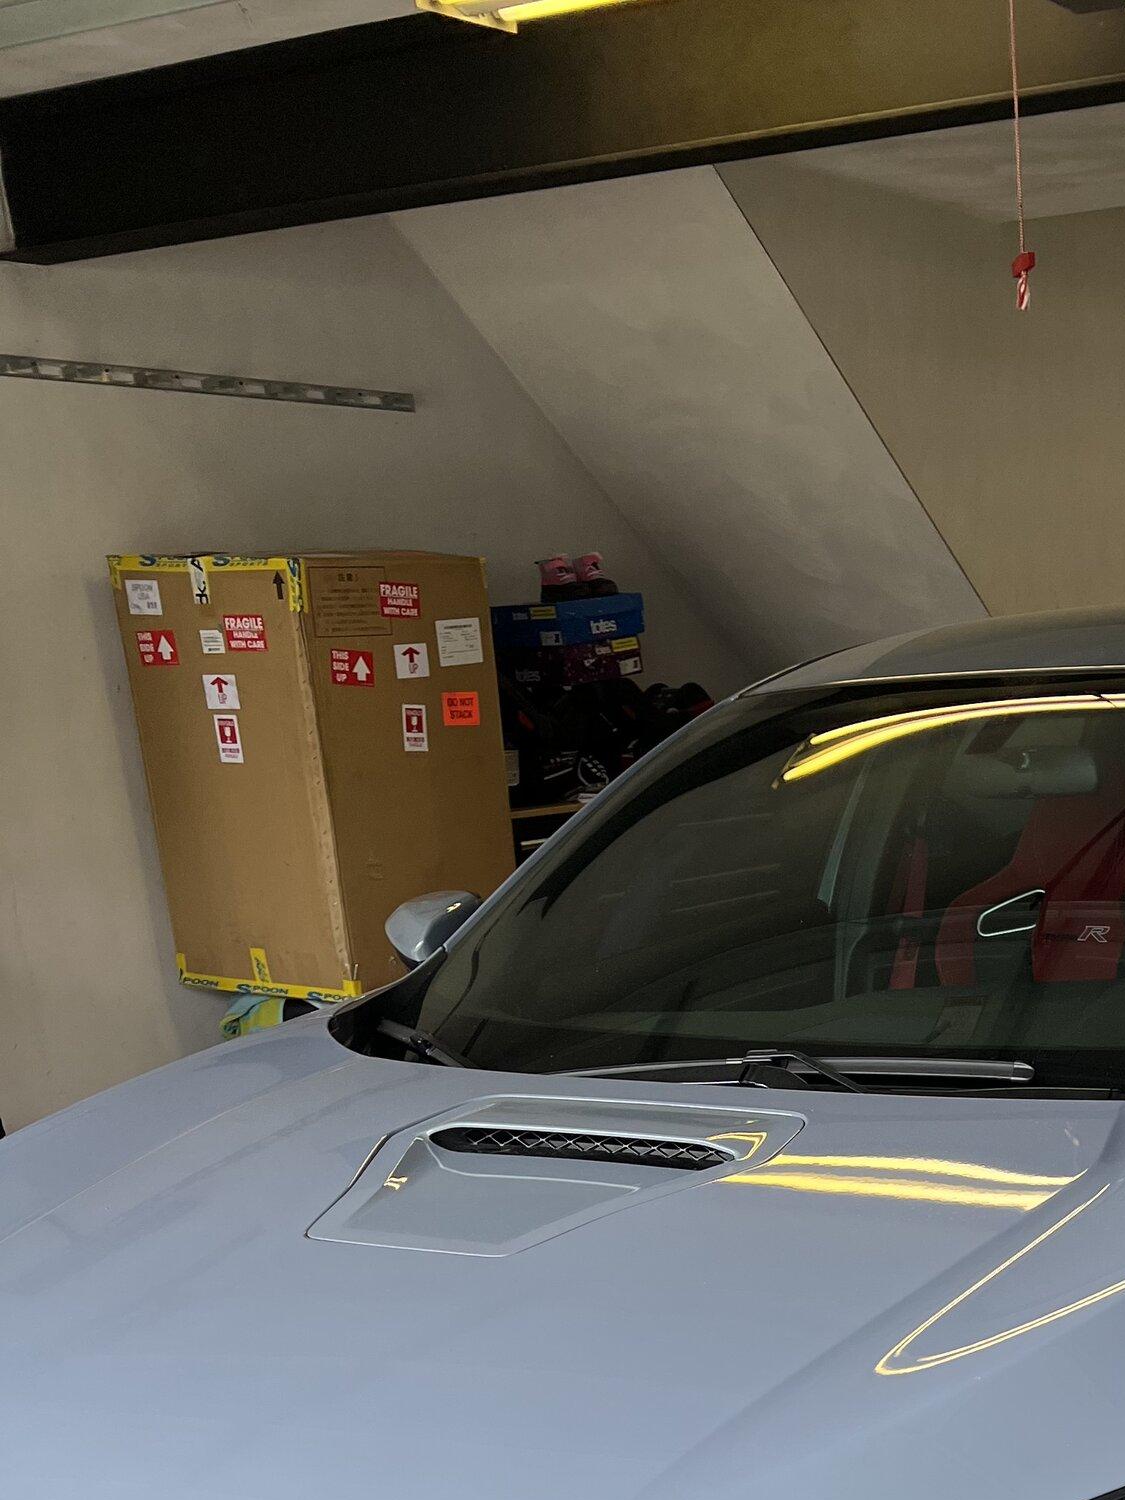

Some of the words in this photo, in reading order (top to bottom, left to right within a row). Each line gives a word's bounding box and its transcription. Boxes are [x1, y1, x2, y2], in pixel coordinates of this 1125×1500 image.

[380, 584, 418, 599] FRAGILE
[383, 607, 400, 616] WITH
[401, 607, 418, 617] CARE
[225, 617, 263, 631] FRAGILE
[247, 640, 265, 650] CARE
[331, 650, 349, 660] THIS
[332, 661, 350, 672] SIDE
[408, 663, 419, 674] UP
[336, 673, 348, 682] UP
[446, 698, 458, 707] DO
[459, 697, 474, 706] NOT
[449, 710, 473, 720] STACK
[1077, 925, 1111, 943] R
[236, 982, 289, 996] SPOON
